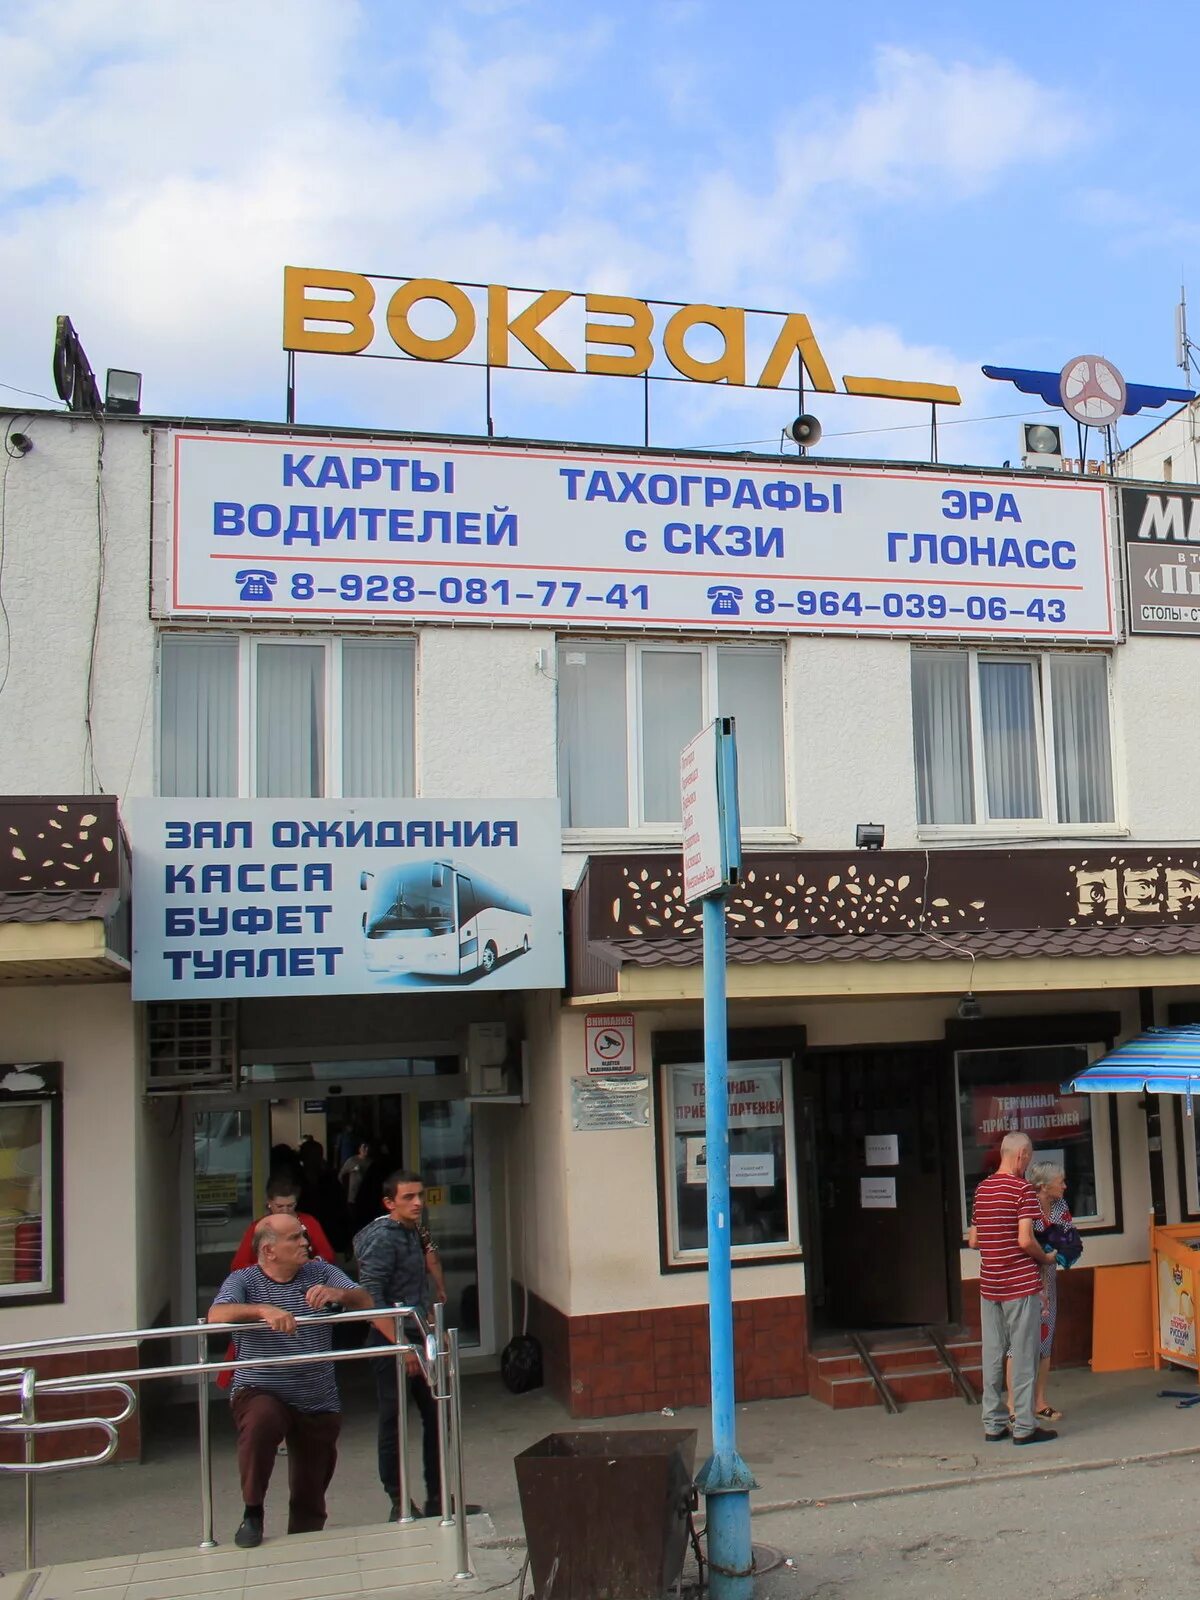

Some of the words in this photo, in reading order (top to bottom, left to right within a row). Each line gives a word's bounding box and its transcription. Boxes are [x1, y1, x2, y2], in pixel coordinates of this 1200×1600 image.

[283, 453, 454, 494] КАРТЫ
[559, 467, 842, 514] ТАХОГРАФЫ
[941, 489, 1022, 523] ЭРА
[213, 501, 518, 547] ВОДИТЕЛЕЙ
[663, 522, 784, 558] СКЗИ
[887, 532, 1077, 570] ГЛОНАСС
[1178, 552, 1186, 563] в
[291, 572, 648, 610] 8-928-081-77-41
[754, 588, 1066, 623] 8-964-039-06-43
[1142, 606, 1182, 620] СТОЛЫ
[164, 820, 253, 849] ЗАЛ
[271, 820, 519, 849] ОЖИДАНИЯ
[164, 862, 333, 894] КАССА
[164, 904, 333, 938] БУФЕТ
[162, 946, 344, 981] ТУАЛЕТ
[1023, 1111, 1080, 1130] ПЛАТЕЖЕЙ
